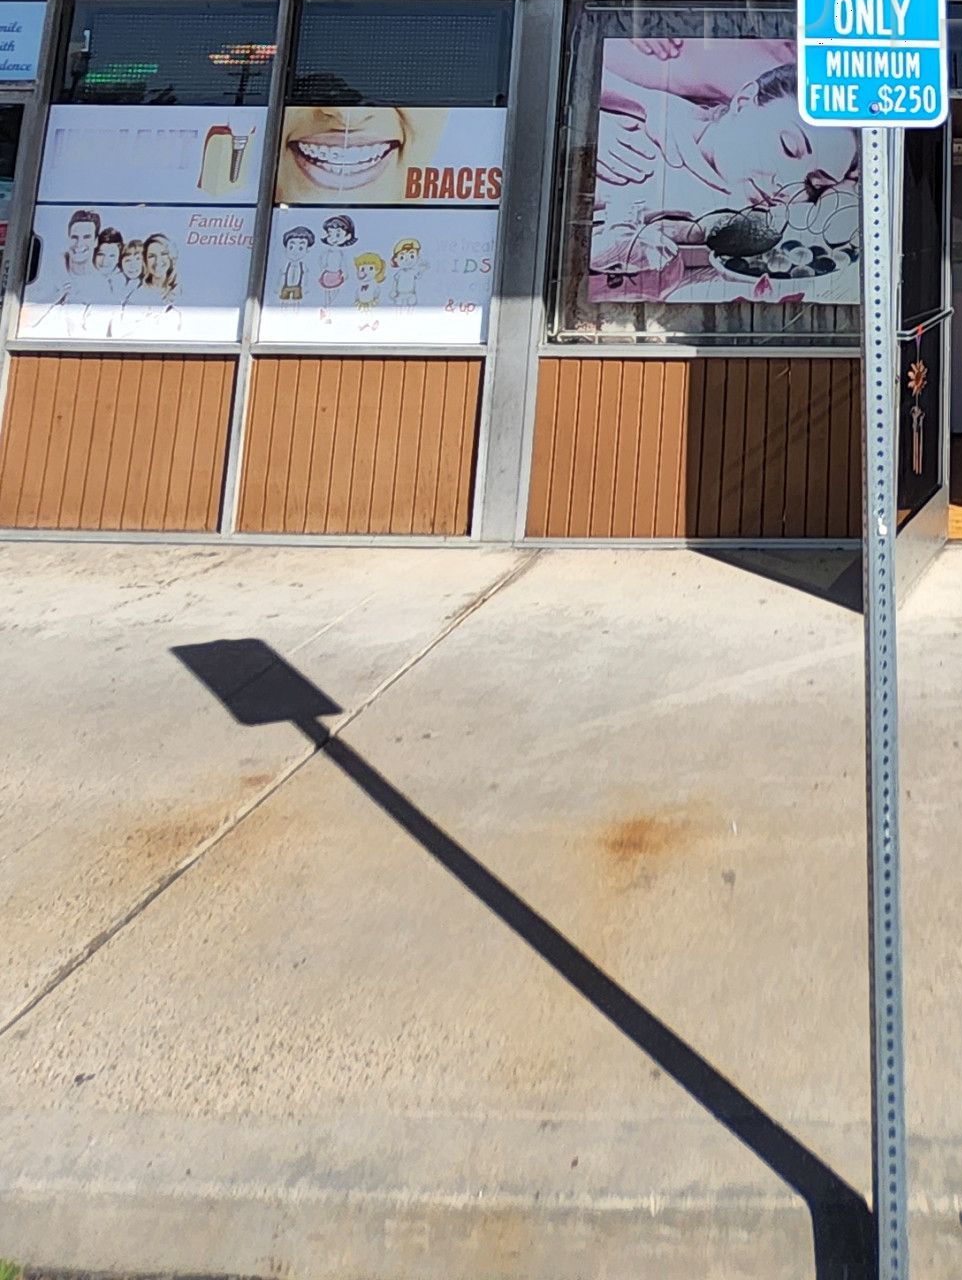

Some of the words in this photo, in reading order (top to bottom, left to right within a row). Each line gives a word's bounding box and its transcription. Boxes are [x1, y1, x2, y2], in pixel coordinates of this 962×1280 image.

[826, 50, 920, 79] MINIMUM
[810, 84, 859, 112] FINE
[877, 84, 936, 114] $250
[405, 166, 503, 200] BRACES
[189, 213, 244, 231] Family
[186, 231, 256, 249] Dentistry
[438, 258, 492, 273] IDS
